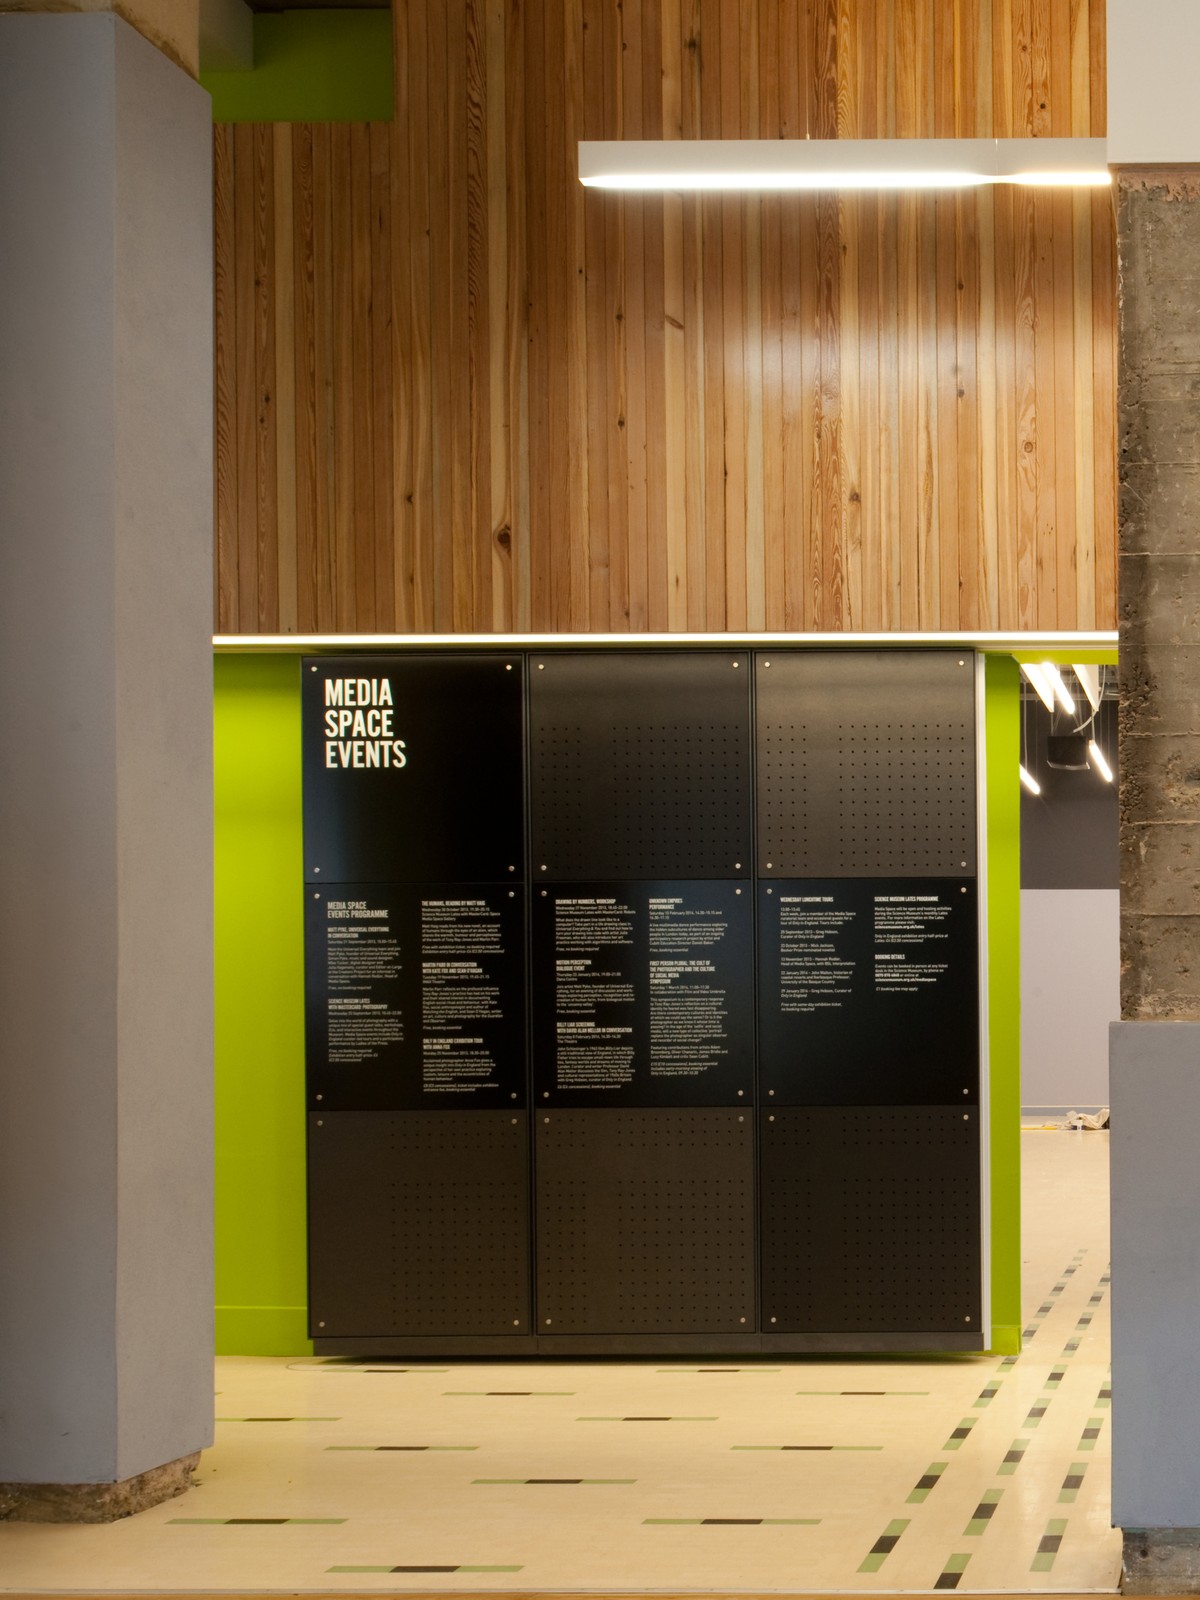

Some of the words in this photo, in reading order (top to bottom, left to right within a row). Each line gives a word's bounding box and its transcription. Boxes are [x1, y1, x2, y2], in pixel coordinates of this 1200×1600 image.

[325, 678, 393, 706] MEDIA
[325, 709, 394, 737] SPACE
[325, 740, 406, 768] EVENTS
